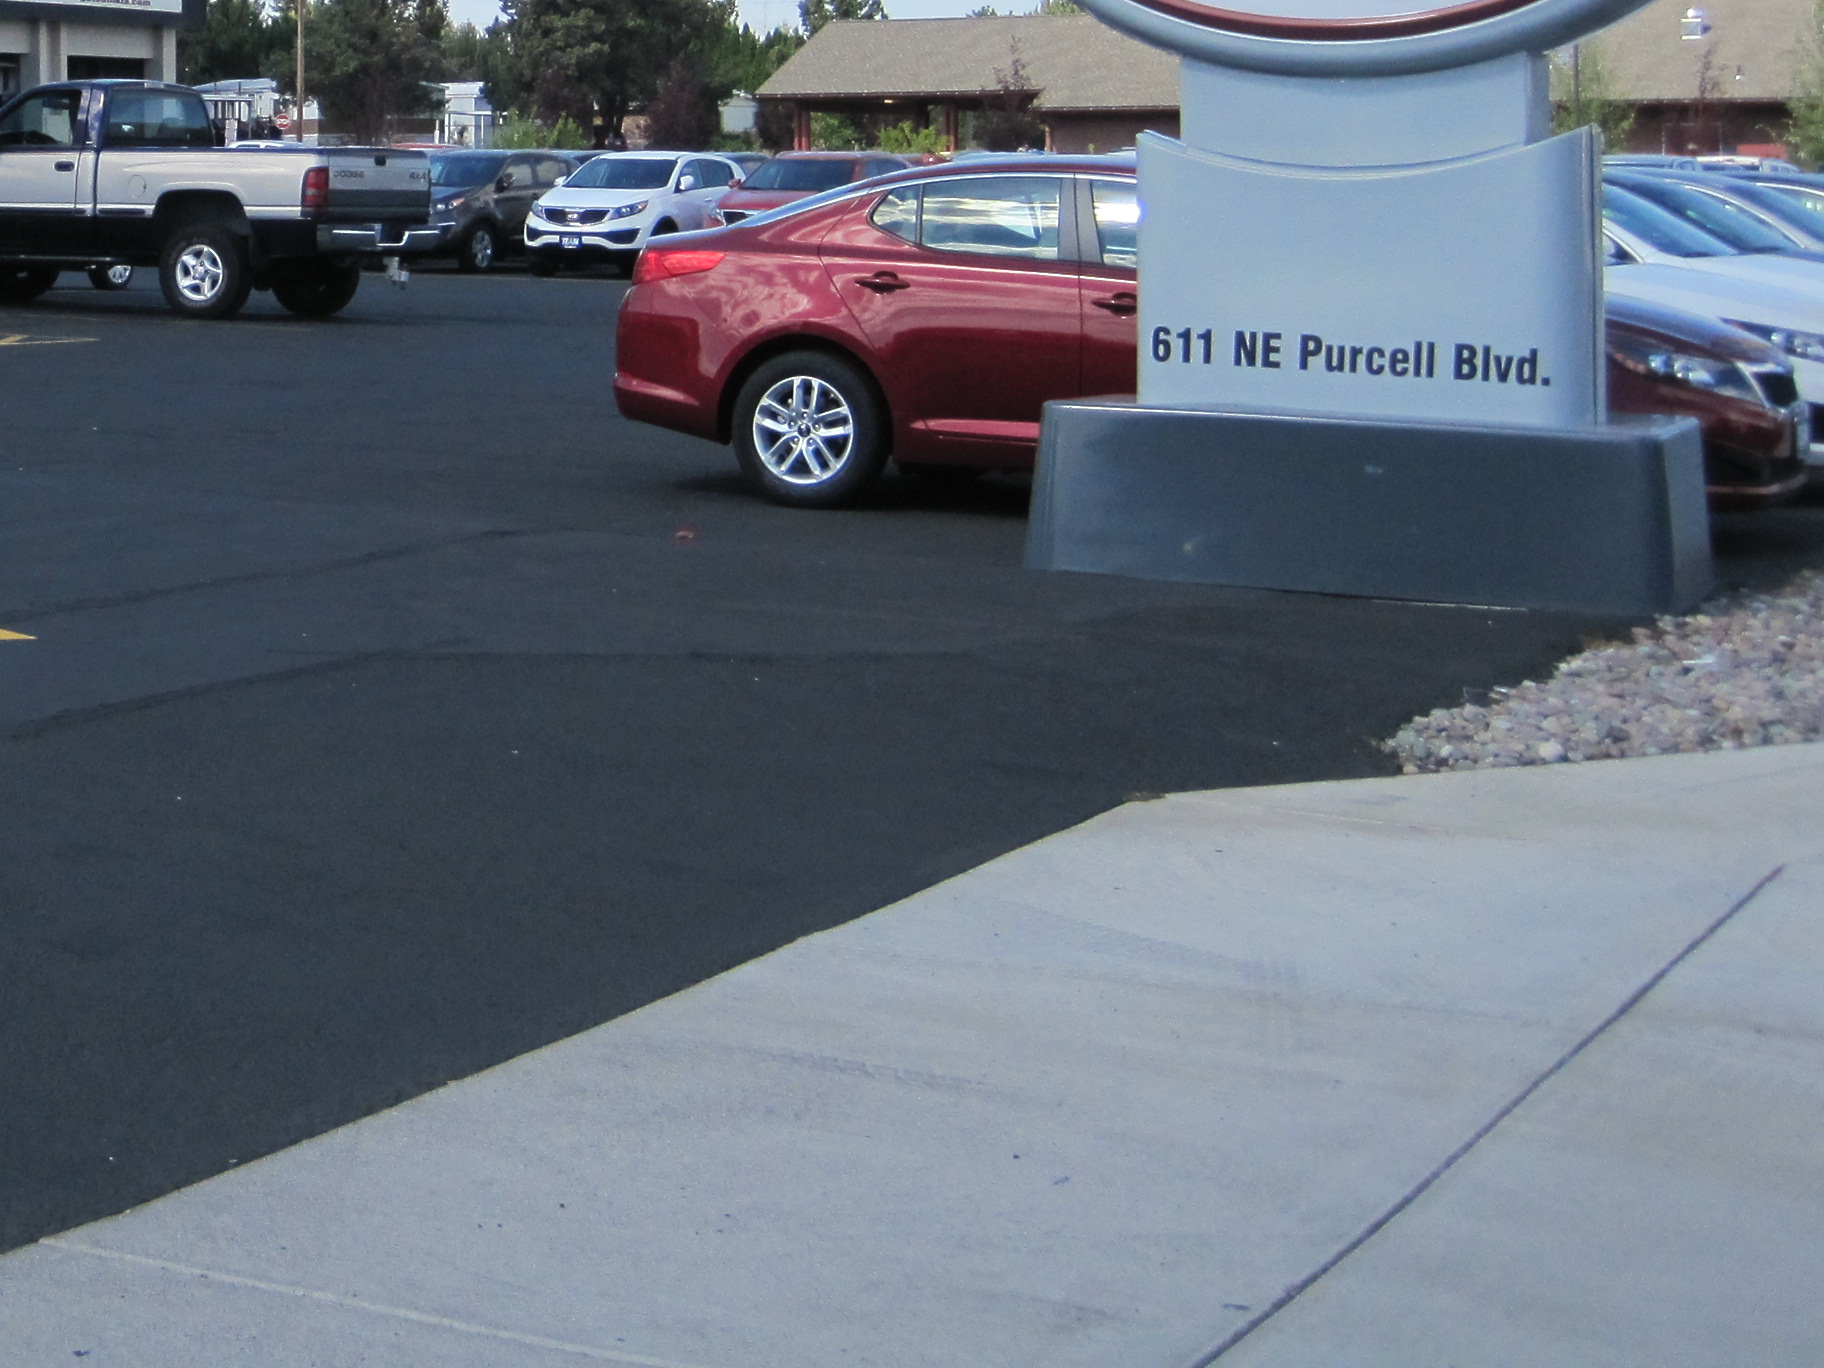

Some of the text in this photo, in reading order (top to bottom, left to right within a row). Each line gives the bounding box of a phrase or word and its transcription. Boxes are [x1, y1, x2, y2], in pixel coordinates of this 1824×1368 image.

[1151, 325, 1552, 387] 611 NE Purcell Blvd.
